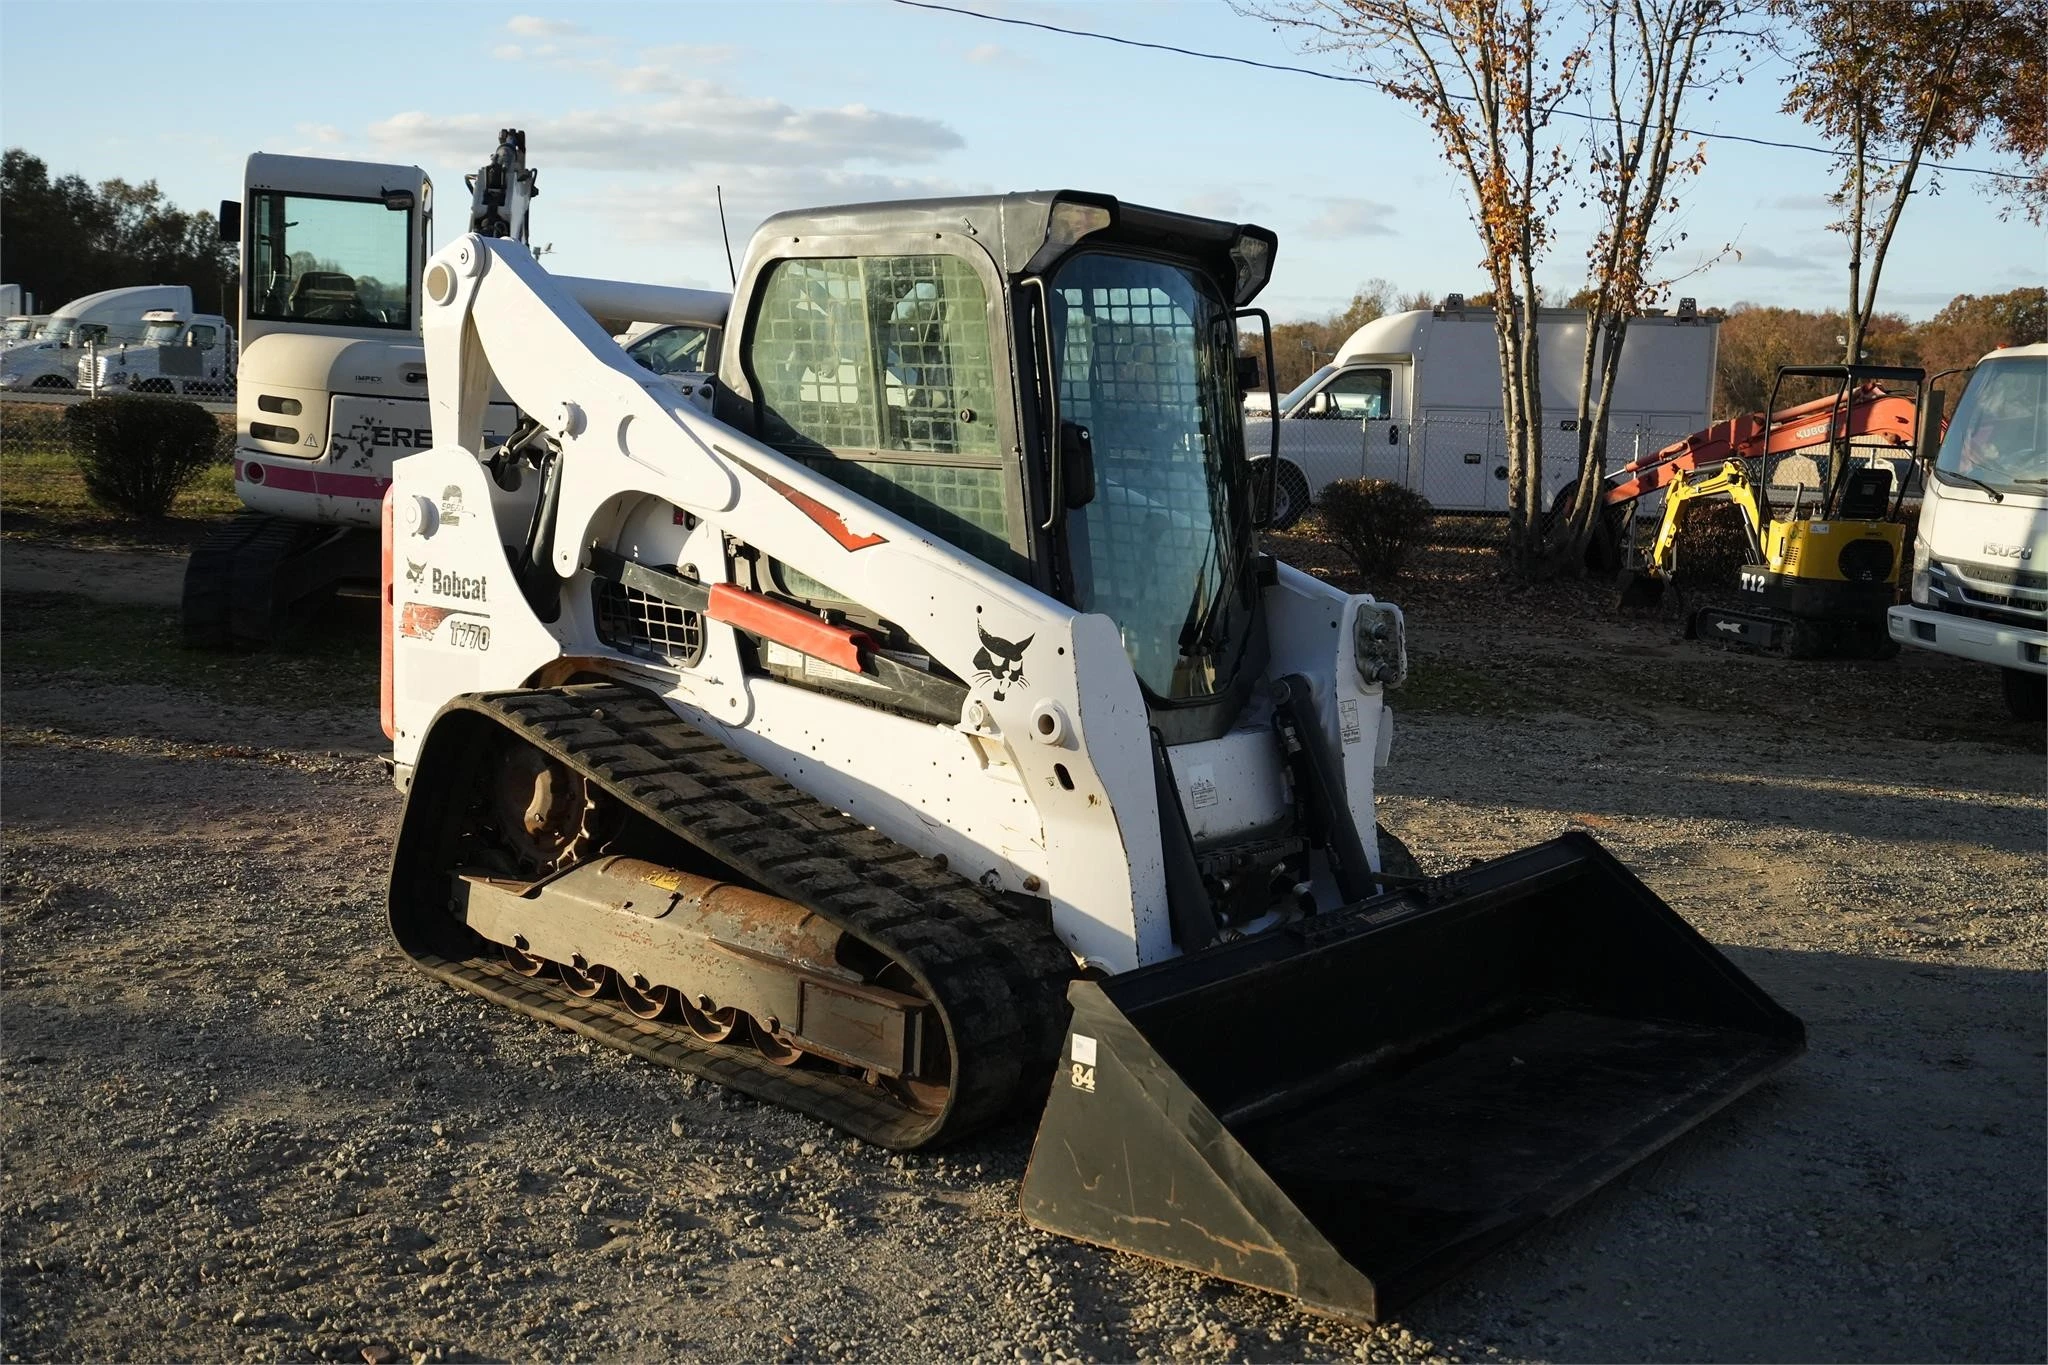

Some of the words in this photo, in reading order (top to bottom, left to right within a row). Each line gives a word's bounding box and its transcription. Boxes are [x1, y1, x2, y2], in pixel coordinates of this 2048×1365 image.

[355, 375, 384, 384] IMPEX
[352, 424, 433, 449] ERE
[440, 484, 463, 527] 2
[1983, 543, 2033, 561] ISUZU
[432, 567, 487, 603] Bobcat
[1741, 572, 1766, 593] T12
[450, 620, 491, 651] T770
[1071, 1063, 1095, 1090] 84
